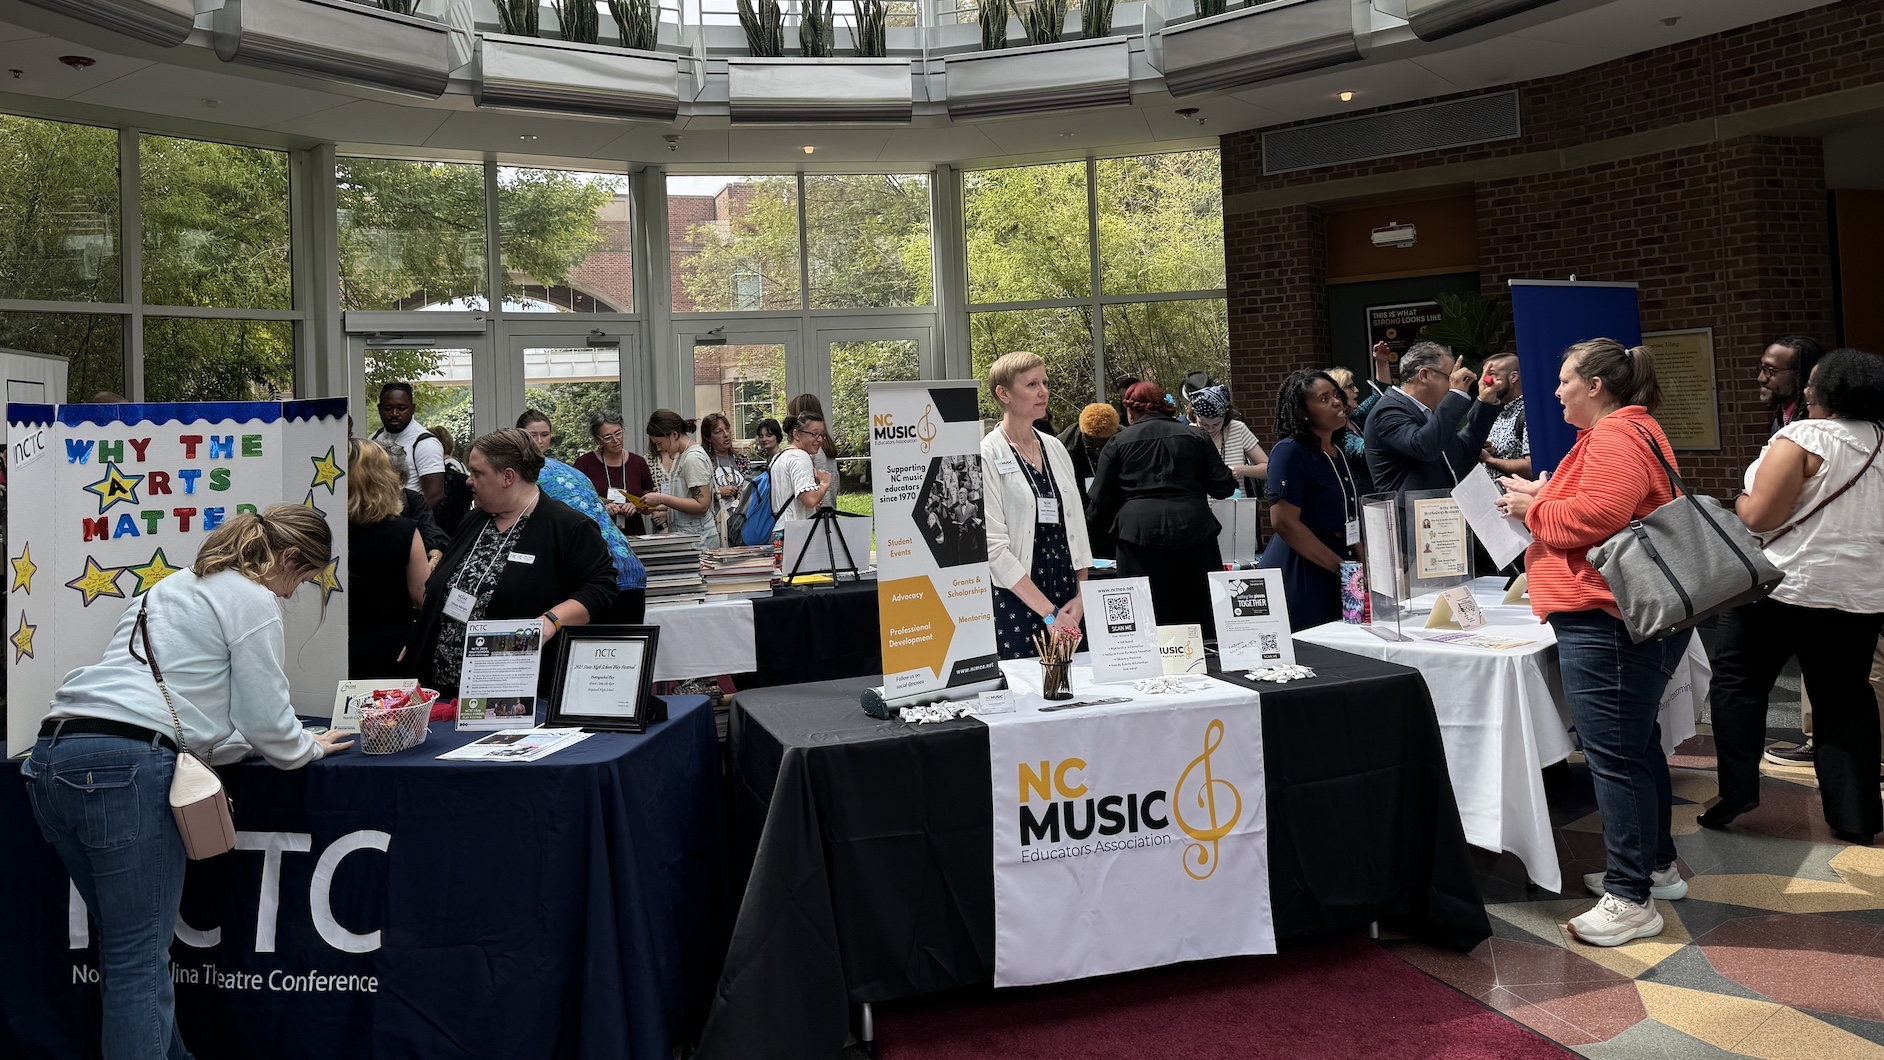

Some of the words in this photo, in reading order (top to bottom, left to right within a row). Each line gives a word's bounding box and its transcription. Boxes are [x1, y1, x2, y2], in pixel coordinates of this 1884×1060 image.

[1396, 309, 1417, 317] WHAT
[1373, 318, 1401, 326] STRONG
[1402, 316, 1425, 324] LOOKS
[1426, 314, 1442, 322] LIKE
[874, 414, 894, 426] NC
[874, 426, 916, 440] MUSIC
[65, 438, 152, 464] WHY
[180, 434, 263, 459] THE
[886, 464, 926, 474] Supporting
[108, 468, 232, 498] ARTS
[902, 473, 922, 482] music
[885, 484, 920, 493] educators
[880, 495, 898, 503] since
[898, 492, 916, 501] 1970
[888, 538, 912, 546] Student
[890, 549, 911, 558] Events
[952, 578, 974, 586] Grants
[892, 592, 924, 602] Advocacy
[948, 587, 987, 598] Scholarships
[1238, 599, 1267, 608] TOGETHER
[958, 613, 990, 624] Mentoring
[890, 622, 931, 636] Professional
[890, 634, 933, 648] Development
[1160, 646, 1184, 654] USIC
[956, 662, 994, 675] www.ncmea.net
[896, 674, 909, 682] Follow
[1018, 758, 1089, 803] NC
[1020, 790, 1170, 846] MUSIC
[1021, 844, 1092, 863] Educators
[1094, 832, 1172, 854] Association
[69, 830, 392, 954] TC
[171, 962, 198, 984] lina
[202, 964, 263, 991] Theatre
[268, 970, 379, 993] Conference
